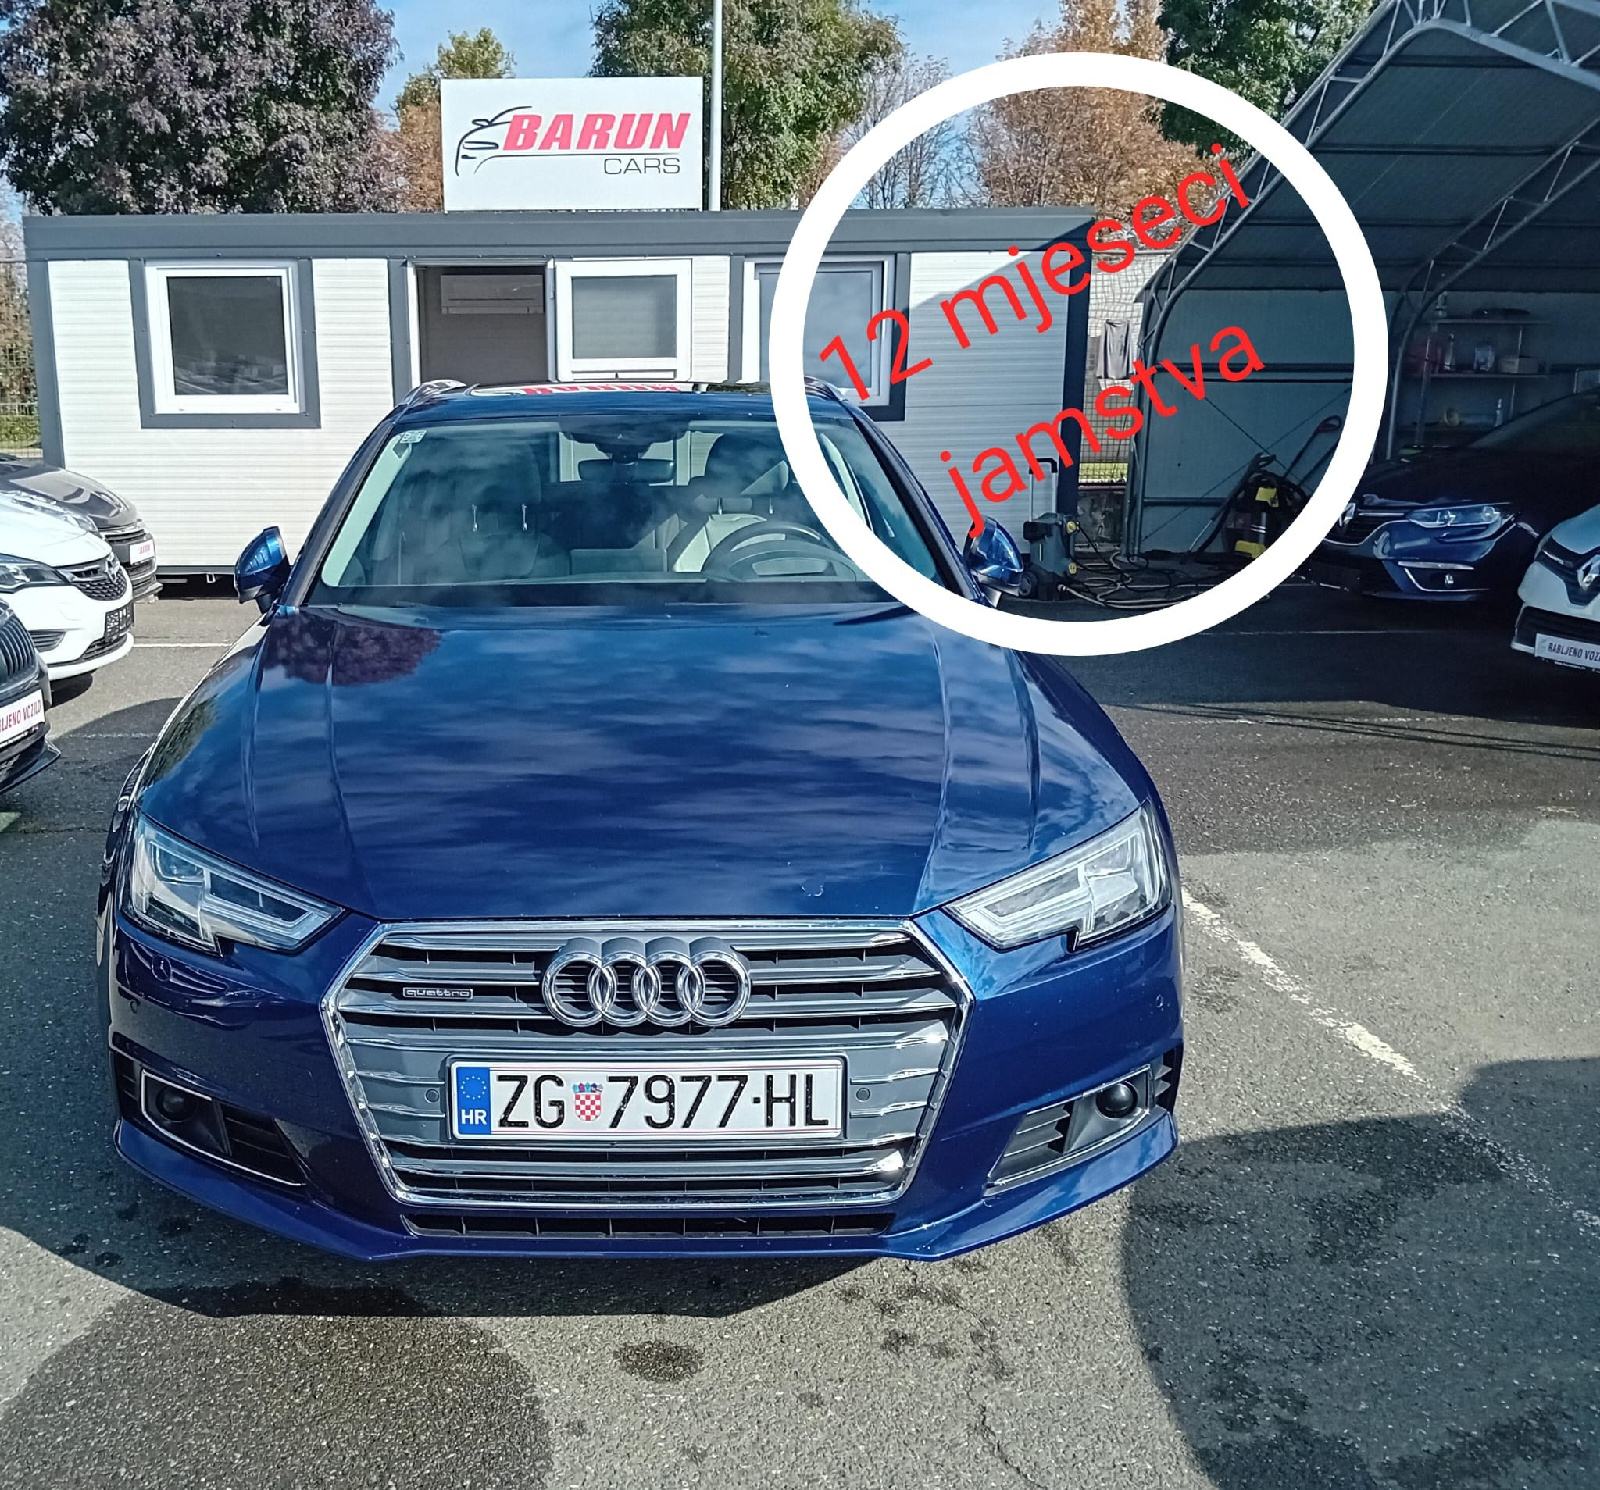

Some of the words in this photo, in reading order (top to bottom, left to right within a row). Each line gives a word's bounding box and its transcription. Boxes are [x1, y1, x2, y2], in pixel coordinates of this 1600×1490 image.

[502, 113, 691, 150] BARUN
[604, 158, 681, 175] CARS
[0, 710, 21, 733] LJENO
[406, 988, 470, 997] quattro
[497, 1074, 565, 1129] ZG
[461, 1109, 487, 1126] HR
